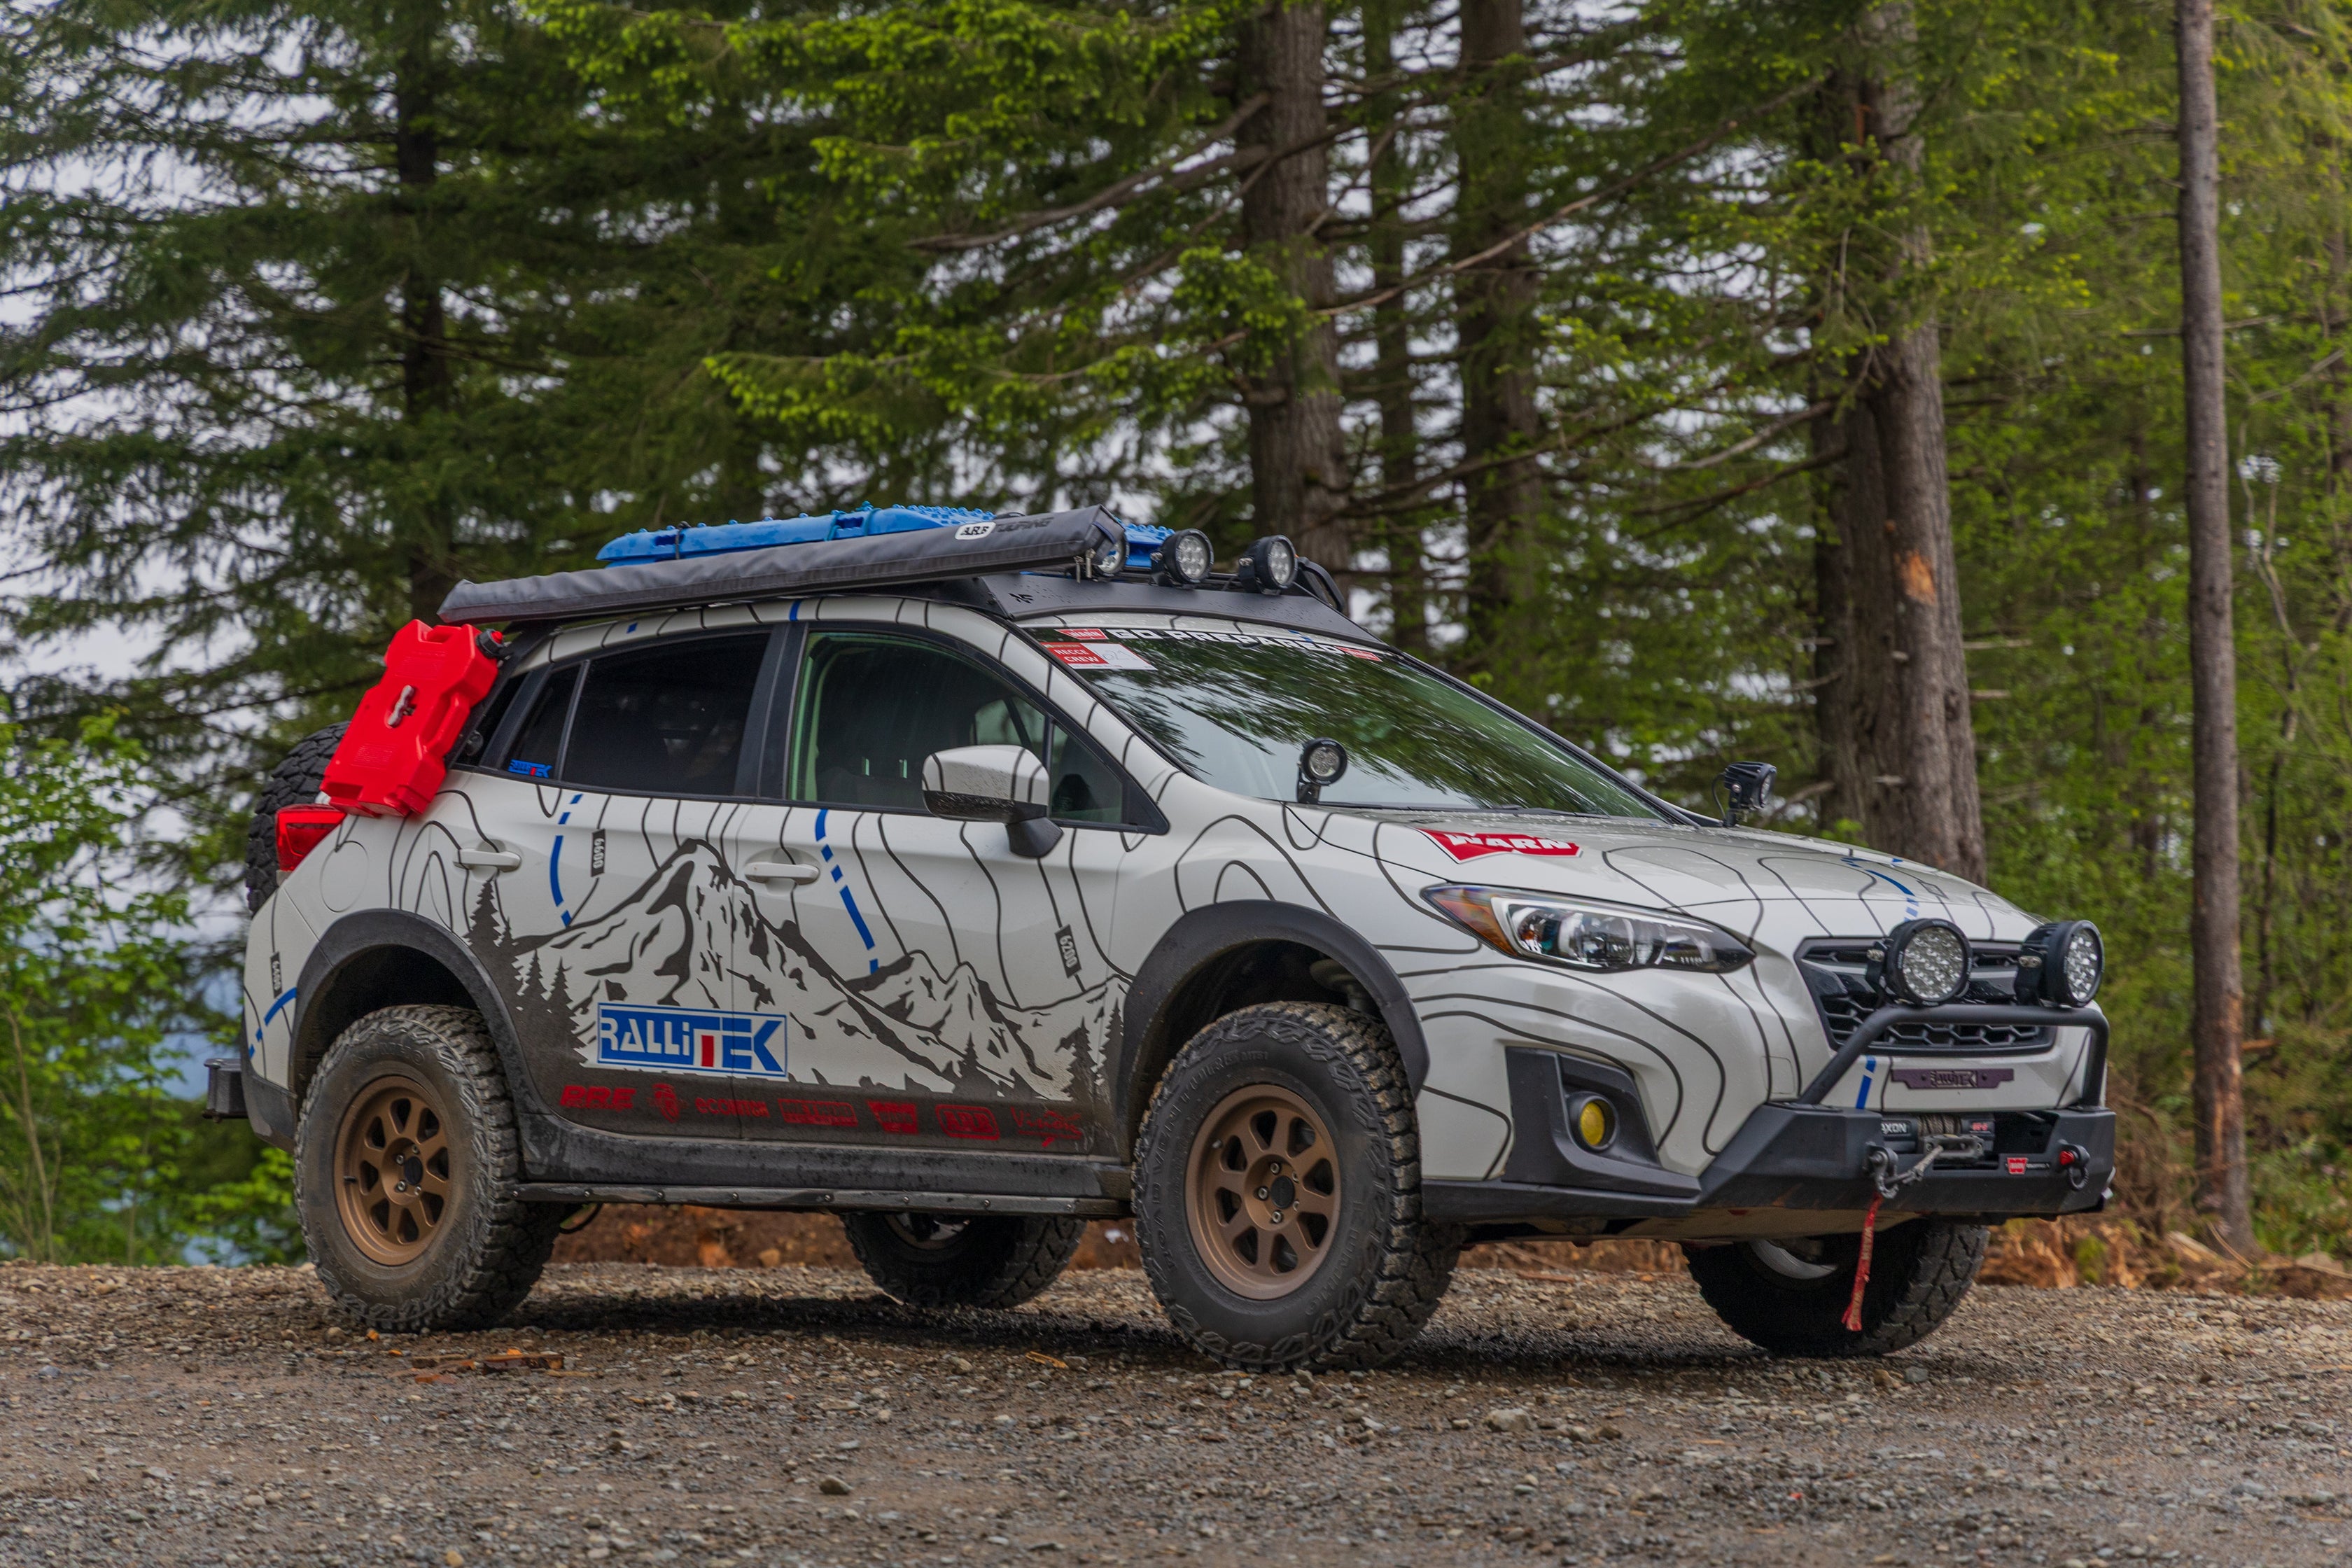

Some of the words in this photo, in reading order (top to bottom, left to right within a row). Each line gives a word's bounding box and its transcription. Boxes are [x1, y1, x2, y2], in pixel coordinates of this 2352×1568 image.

[1105, 629, 1163, 640] GO
[1162, 630, 1346, 655] PREPARED
[593, 838, 605, 869] 6600
[1444, 833, 1572, 849] WARN
[1059, 934, 1078, 969] 6200
